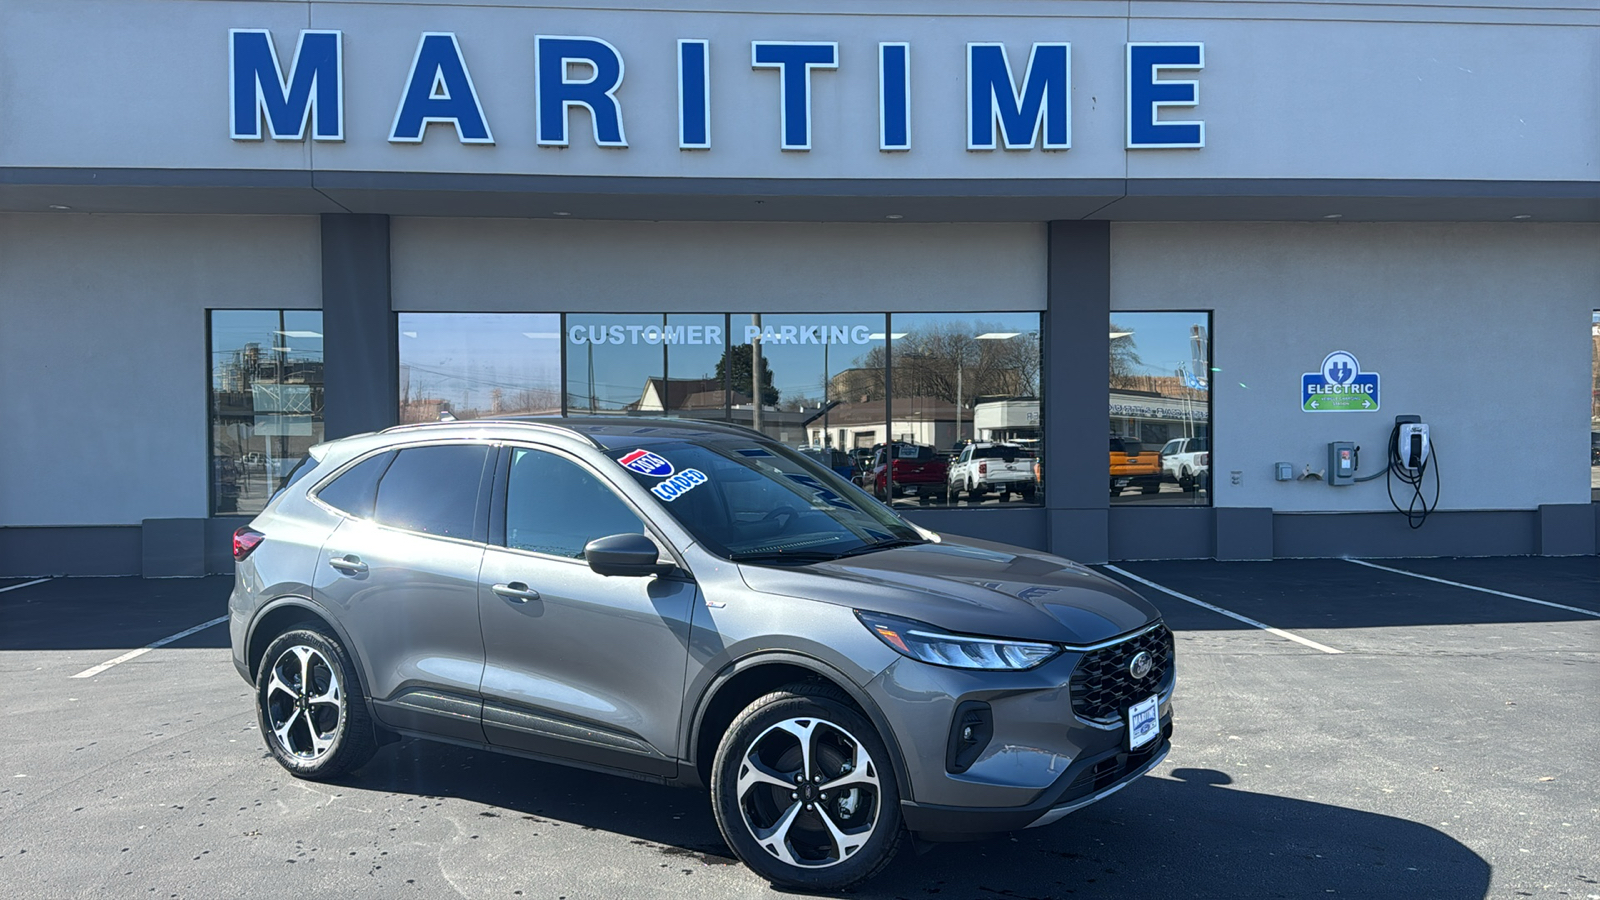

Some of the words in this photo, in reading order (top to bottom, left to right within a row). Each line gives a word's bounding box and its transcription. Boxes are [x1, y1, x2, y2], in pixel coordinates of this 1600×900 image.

[228, 27, 1206, 152] MARITIME
[569, 325, 723, 345] CUSTOMER
[744, 325, 870, 345] PARKING
[1307, 383, 1374, 394] ELECTRIC
[653, 469, 706, 500] LOADED
